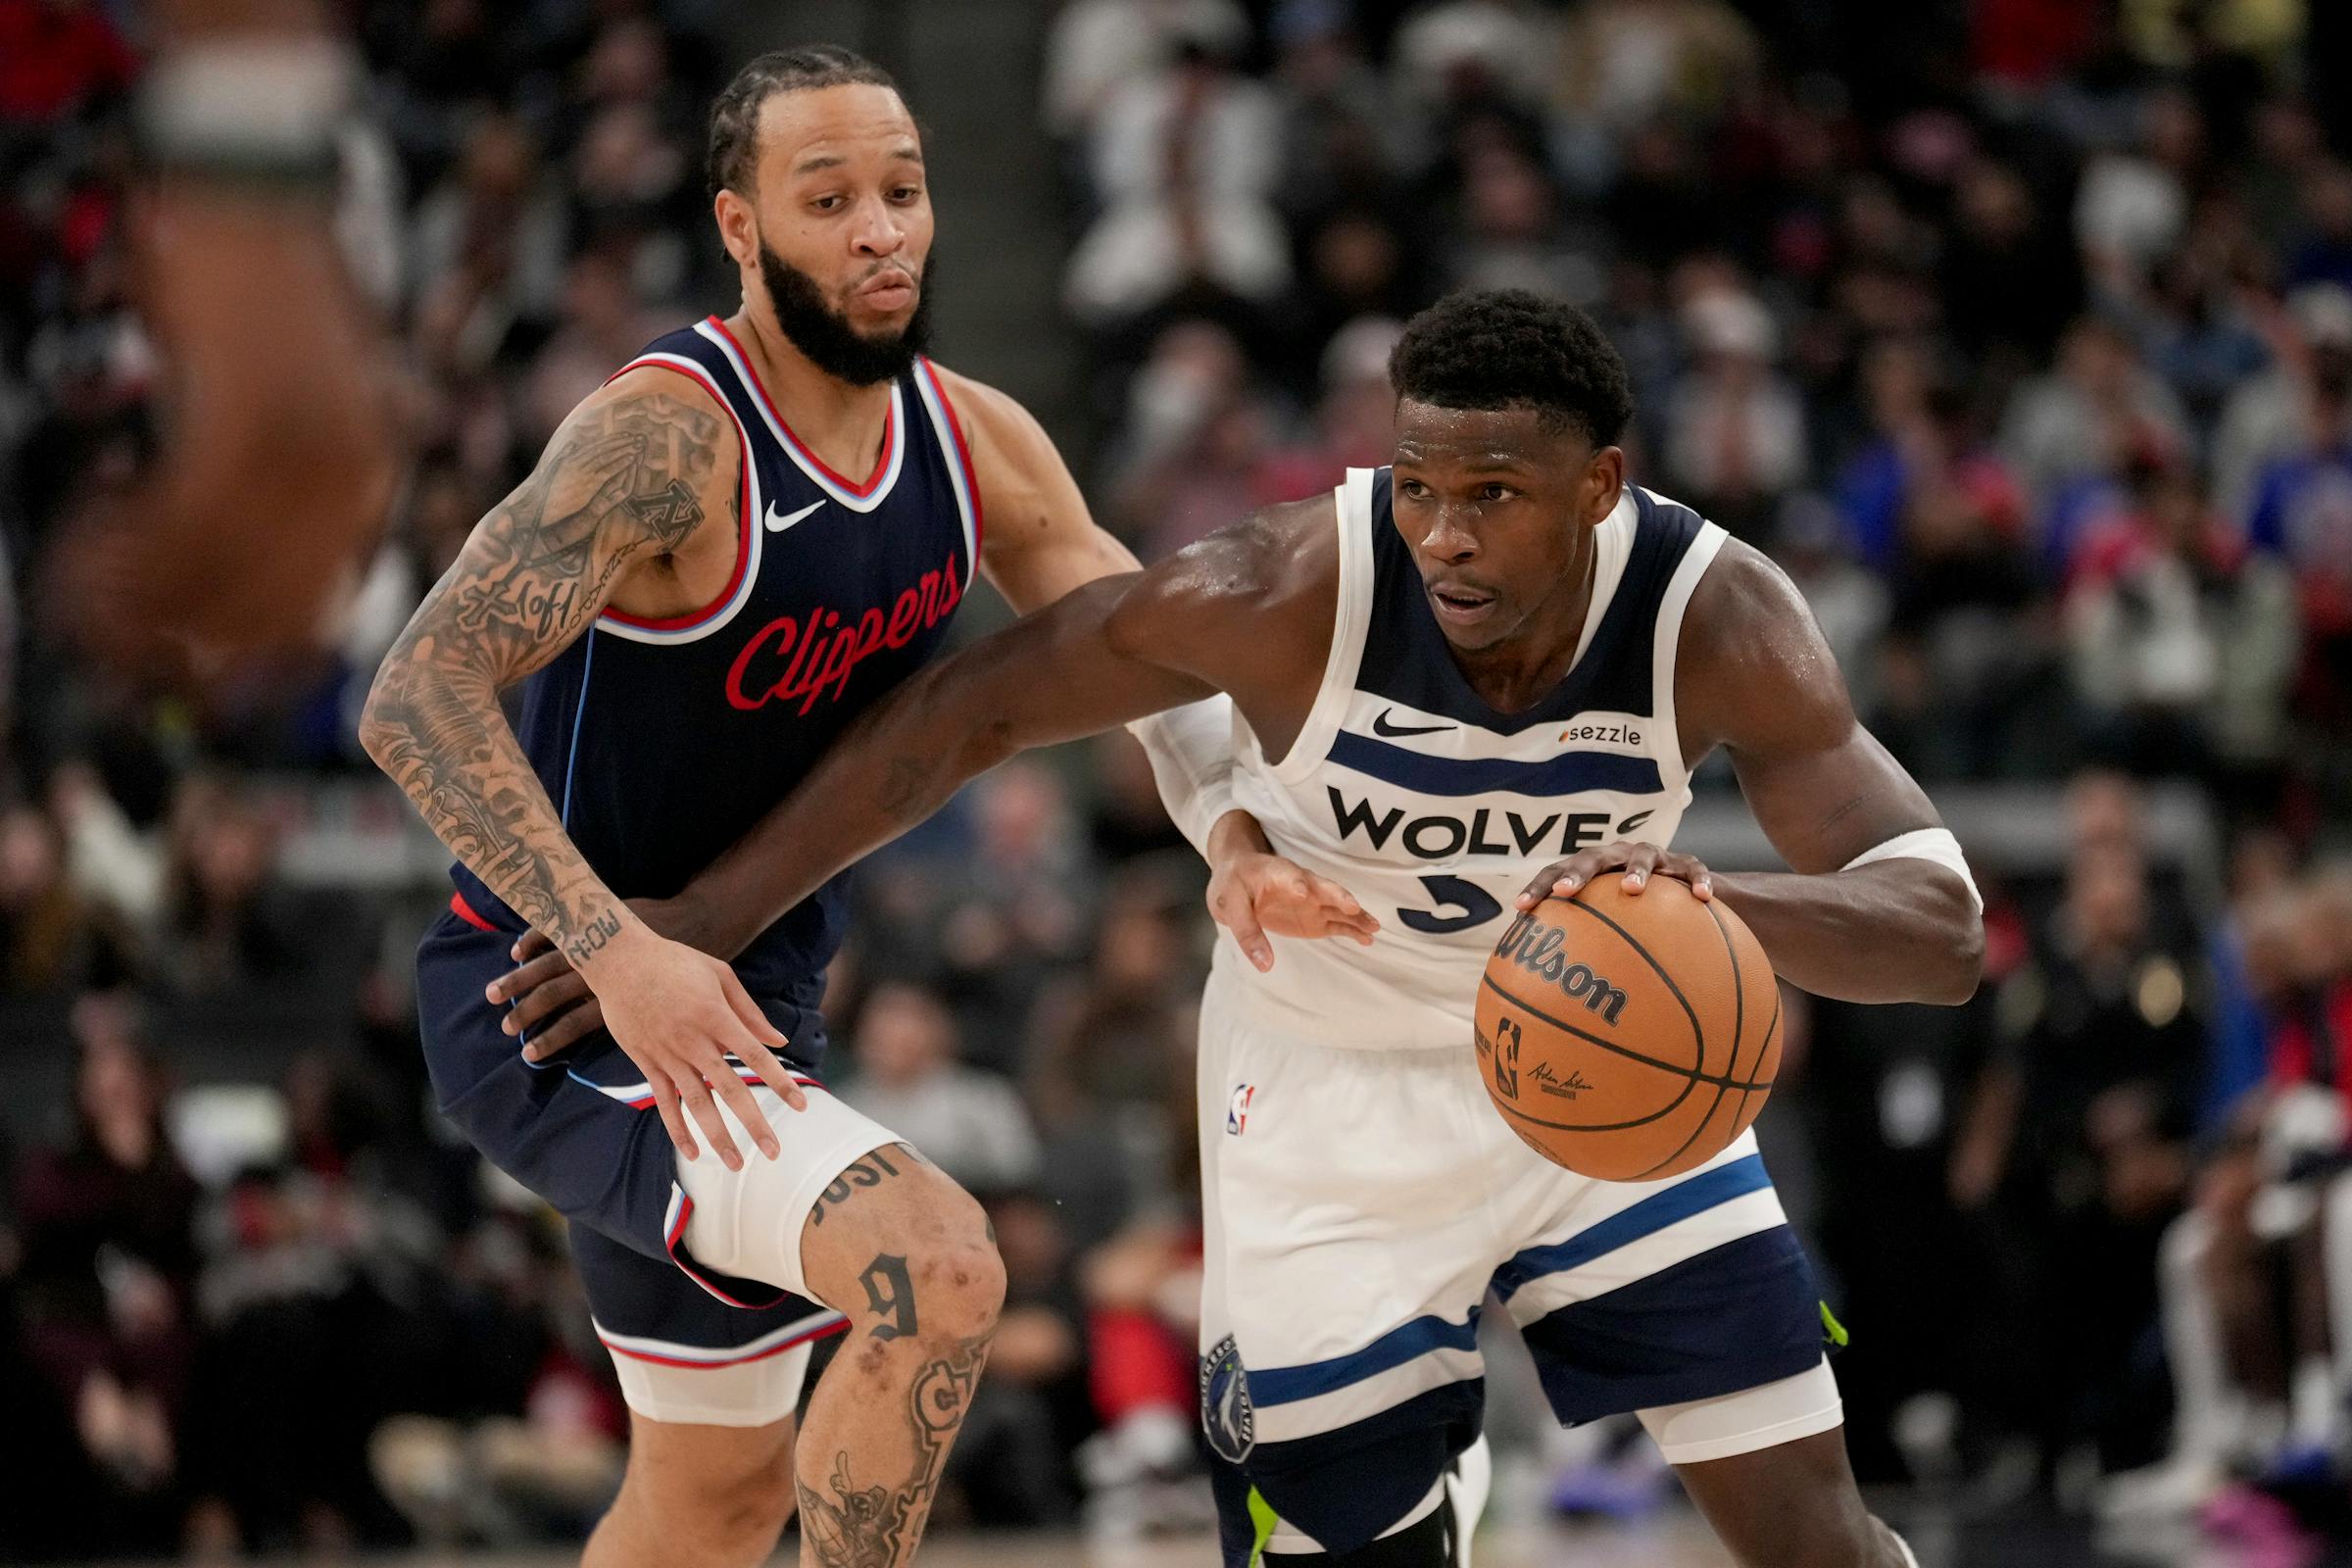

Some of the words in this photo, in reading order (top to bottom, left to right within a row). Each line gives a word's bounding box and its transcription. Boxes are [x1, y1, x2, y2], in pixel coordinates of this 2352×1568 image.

[725, 550, 963, 717] Clippers
[1569, 723, 1642, 746] sezzle
[1494, 911, 1629, 1027] Wilson
